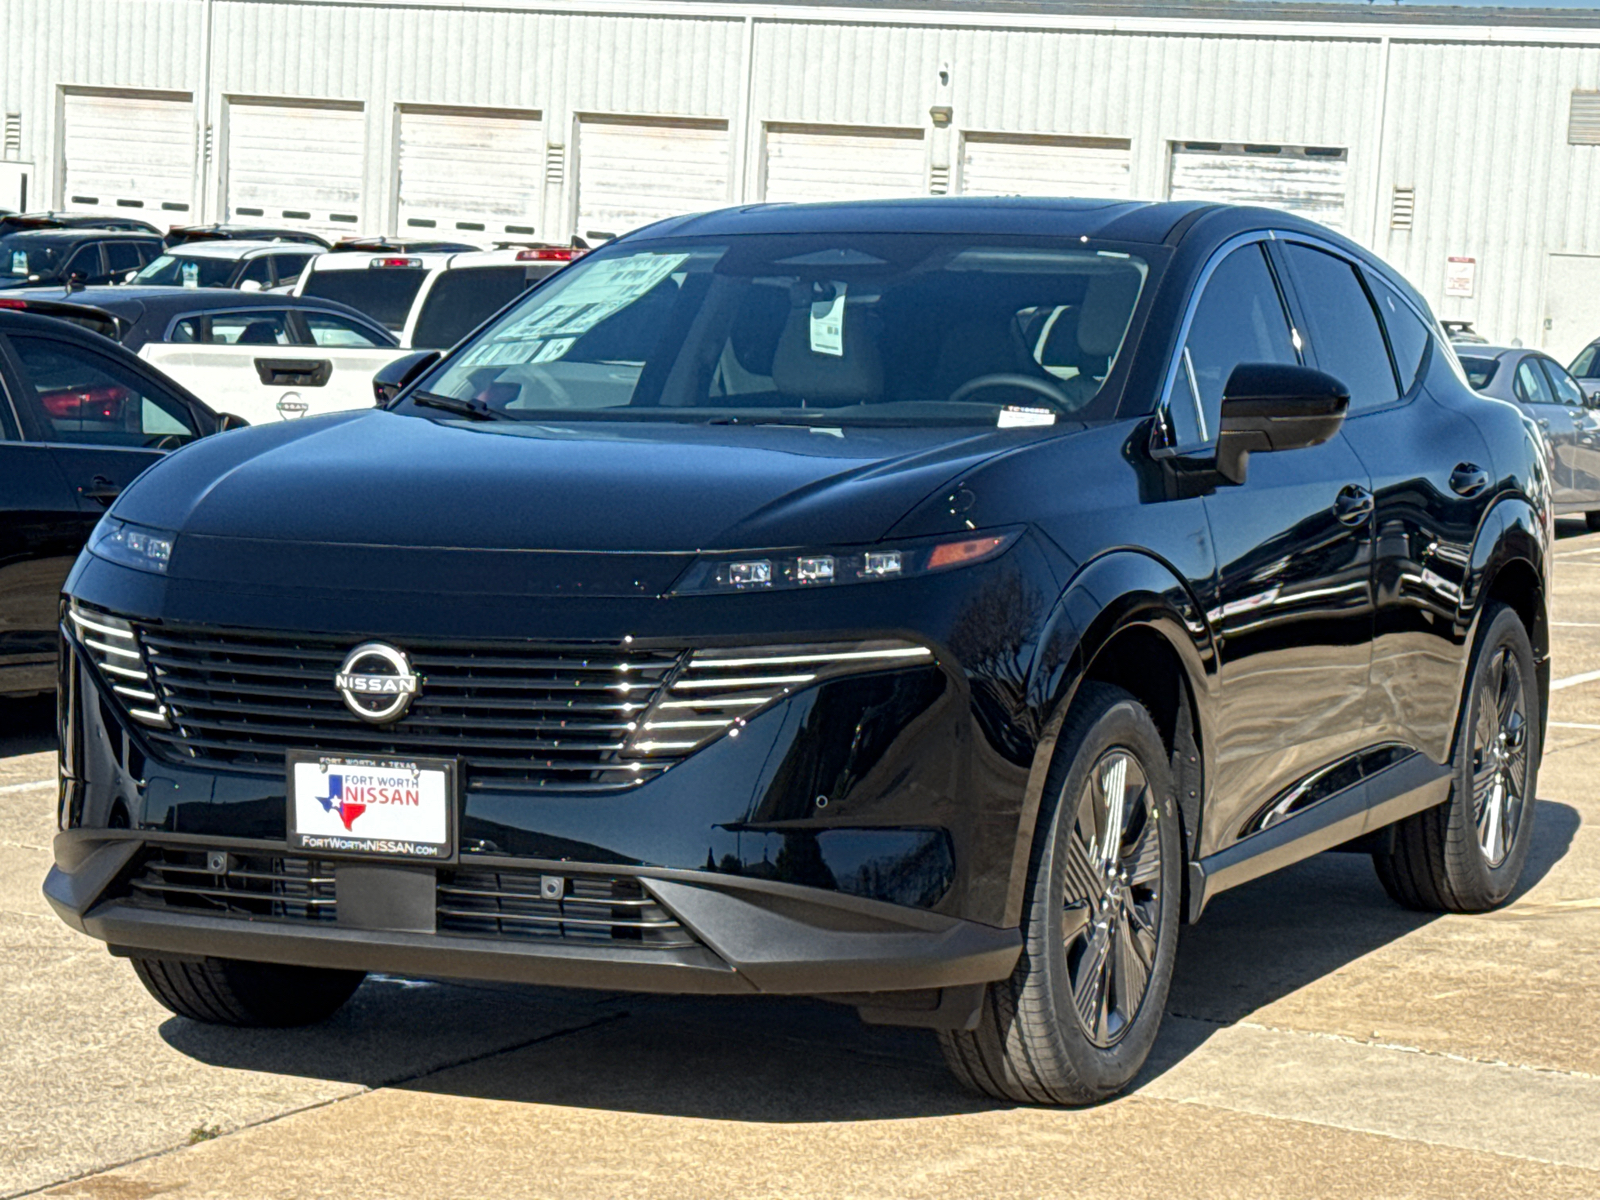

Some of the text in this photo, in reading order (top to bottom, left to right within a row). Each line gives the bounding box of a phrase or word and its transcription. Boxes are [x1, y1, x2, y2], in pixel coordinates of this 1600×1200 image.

[336, 675, 416, 692] NISSAN
[319, 757, 417, 770] FORT WORTH TEXAS
[345, 775, 419, 789] FORT WORTH
[345, 786, 419, 806] NISSAN
